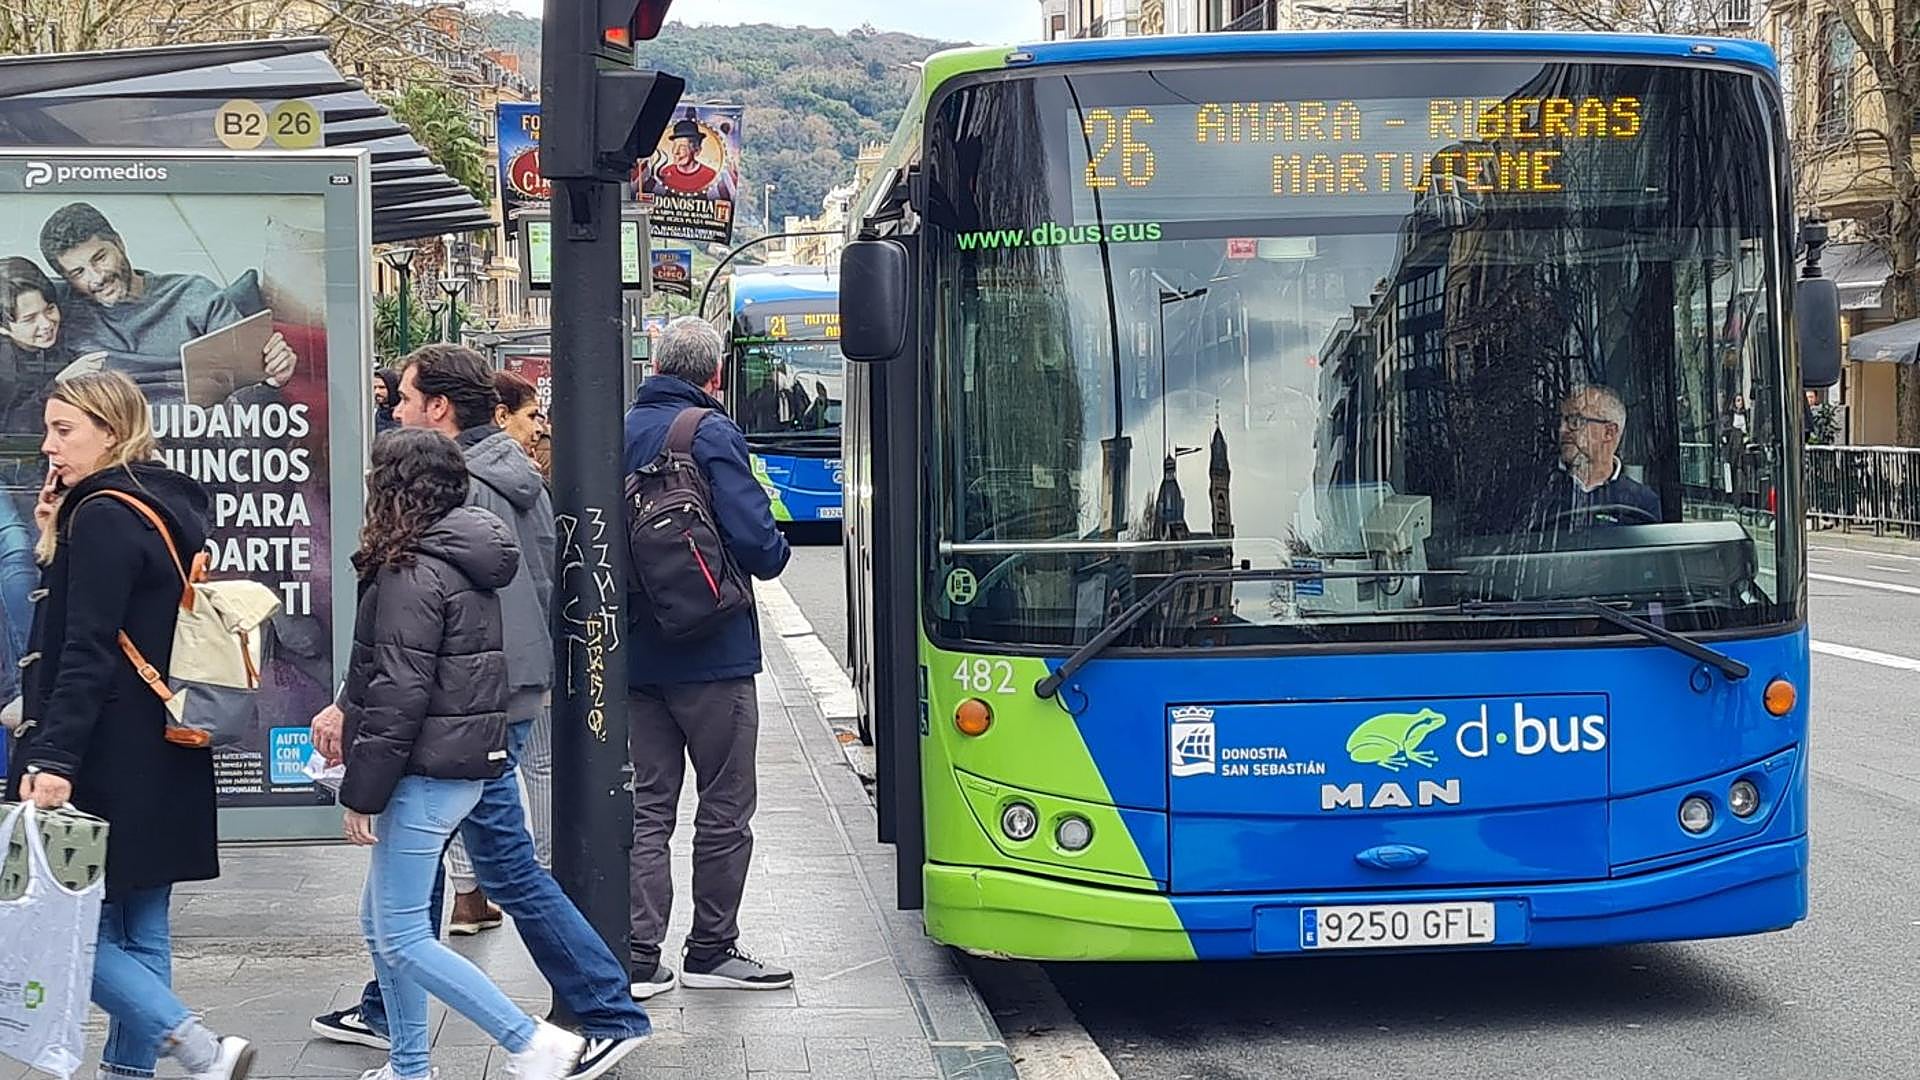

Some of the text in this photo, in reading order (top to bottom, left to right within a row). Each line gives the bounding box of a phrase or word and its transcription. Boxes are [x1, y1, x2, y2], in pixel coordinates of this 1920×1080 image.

[223, 112, 311, 136] B2 26
[1197, 101, 1361, 143] AMARA
[1429, 97, 1641, 139] RIBERAS
[1084, 108, 1155, 188] 26
[58, 162, 168, 184] promedios
[1272, 151, 1562, 194] MARTUTENE
[655, 195, 714, 214] DONOSTIA
[957, 222, 1162, 250] www.dbus.eus
[770, 315, 788, 336] 21
[148, 403, 310, 439] UIDAMOS
[151, 447, 311, 483] NUNCIOS
[215, 492, 311, 528] PARA
[202, 537, 311, 572] DARTE
[279, 582, 311, 615] TI
[953, 657, 1017, 694] 482
[276, 733, 308, 745] AUTO
[276, 747, 300, 759] CON
[1221, 747, 1288, 760] DONOSTIA
[1221, 760, 1325, 776] SAN SEBASTIÁN
[1321, 779, 1461, 810] MAN
[1306, 907, 1486, 942] E 9250 GFL
